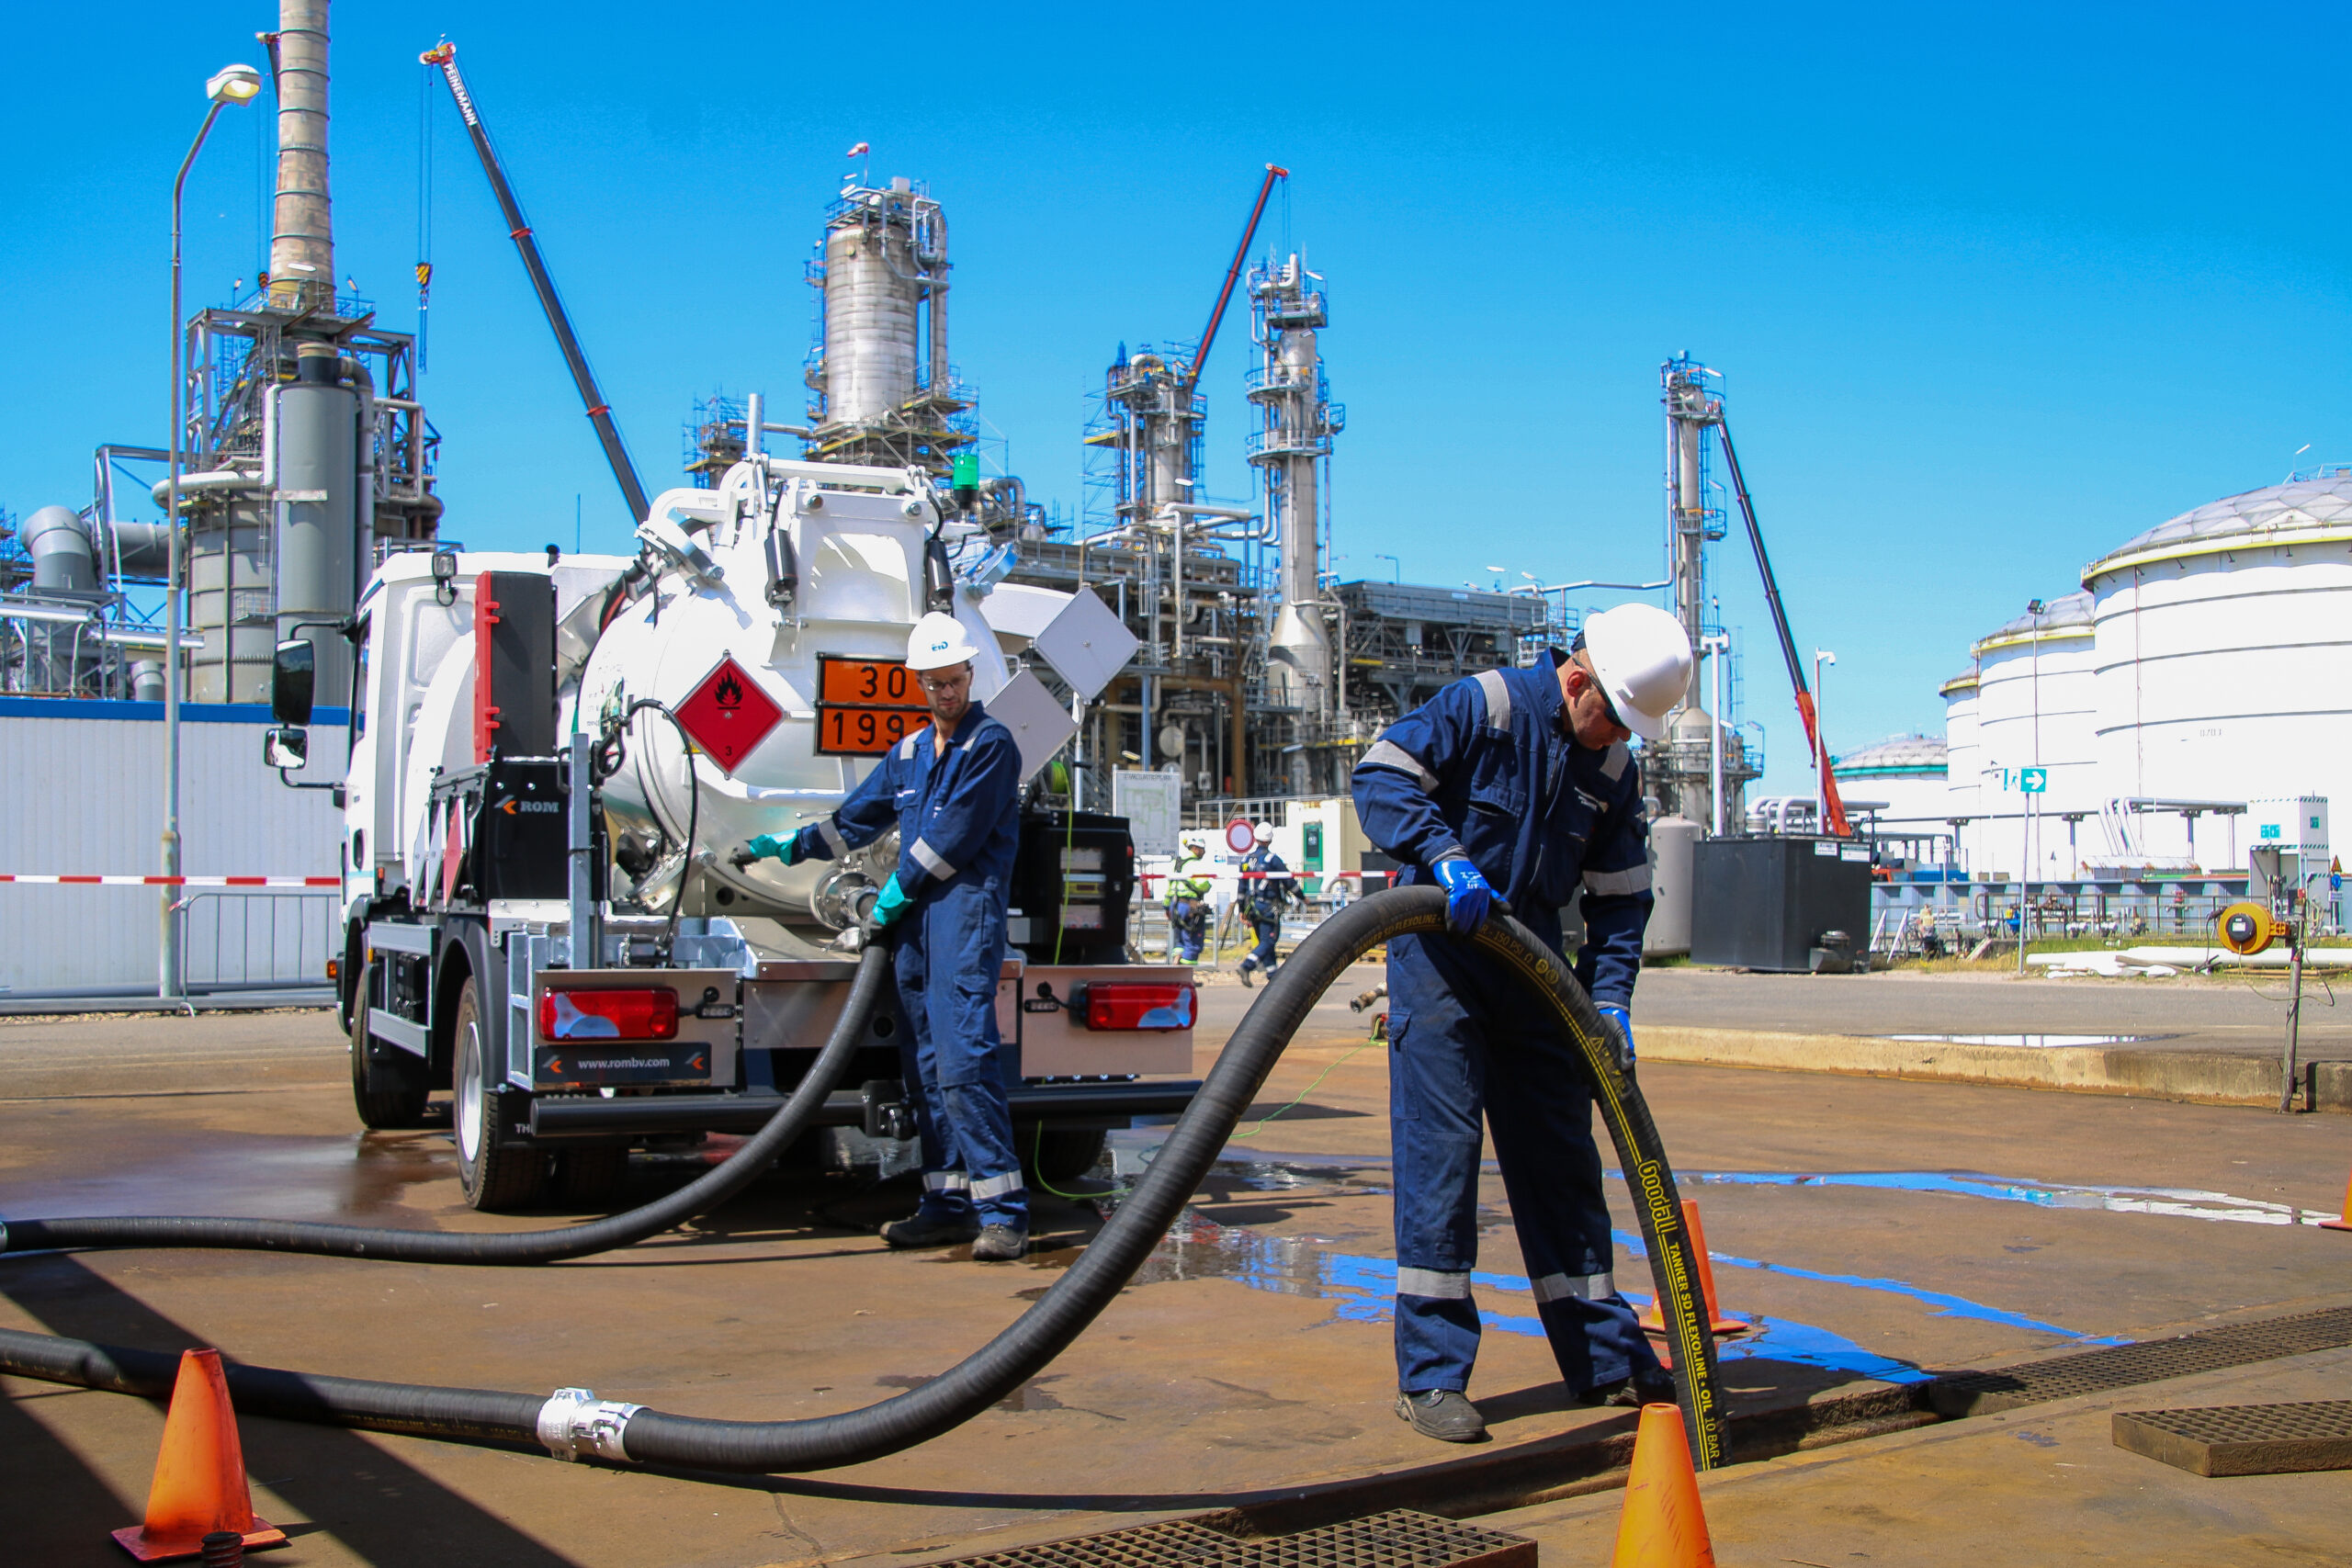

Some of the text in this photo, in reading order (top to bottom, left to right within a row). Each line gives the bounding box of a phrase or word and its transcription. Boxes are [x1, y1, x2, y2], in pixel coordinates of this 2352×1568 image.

[444, 62, 478, 126] PEINEMANN
[859, 665, 906, 698] 30
[725, 746, 732, 756] 3
[520, 801, 560, 813] ROM
[578, 1057, 670, 1069] www.rombv.com
[1637, 1159, 1721, 1459] Goodall TANKER SD FLEXOLINE OIL 10 BAR
